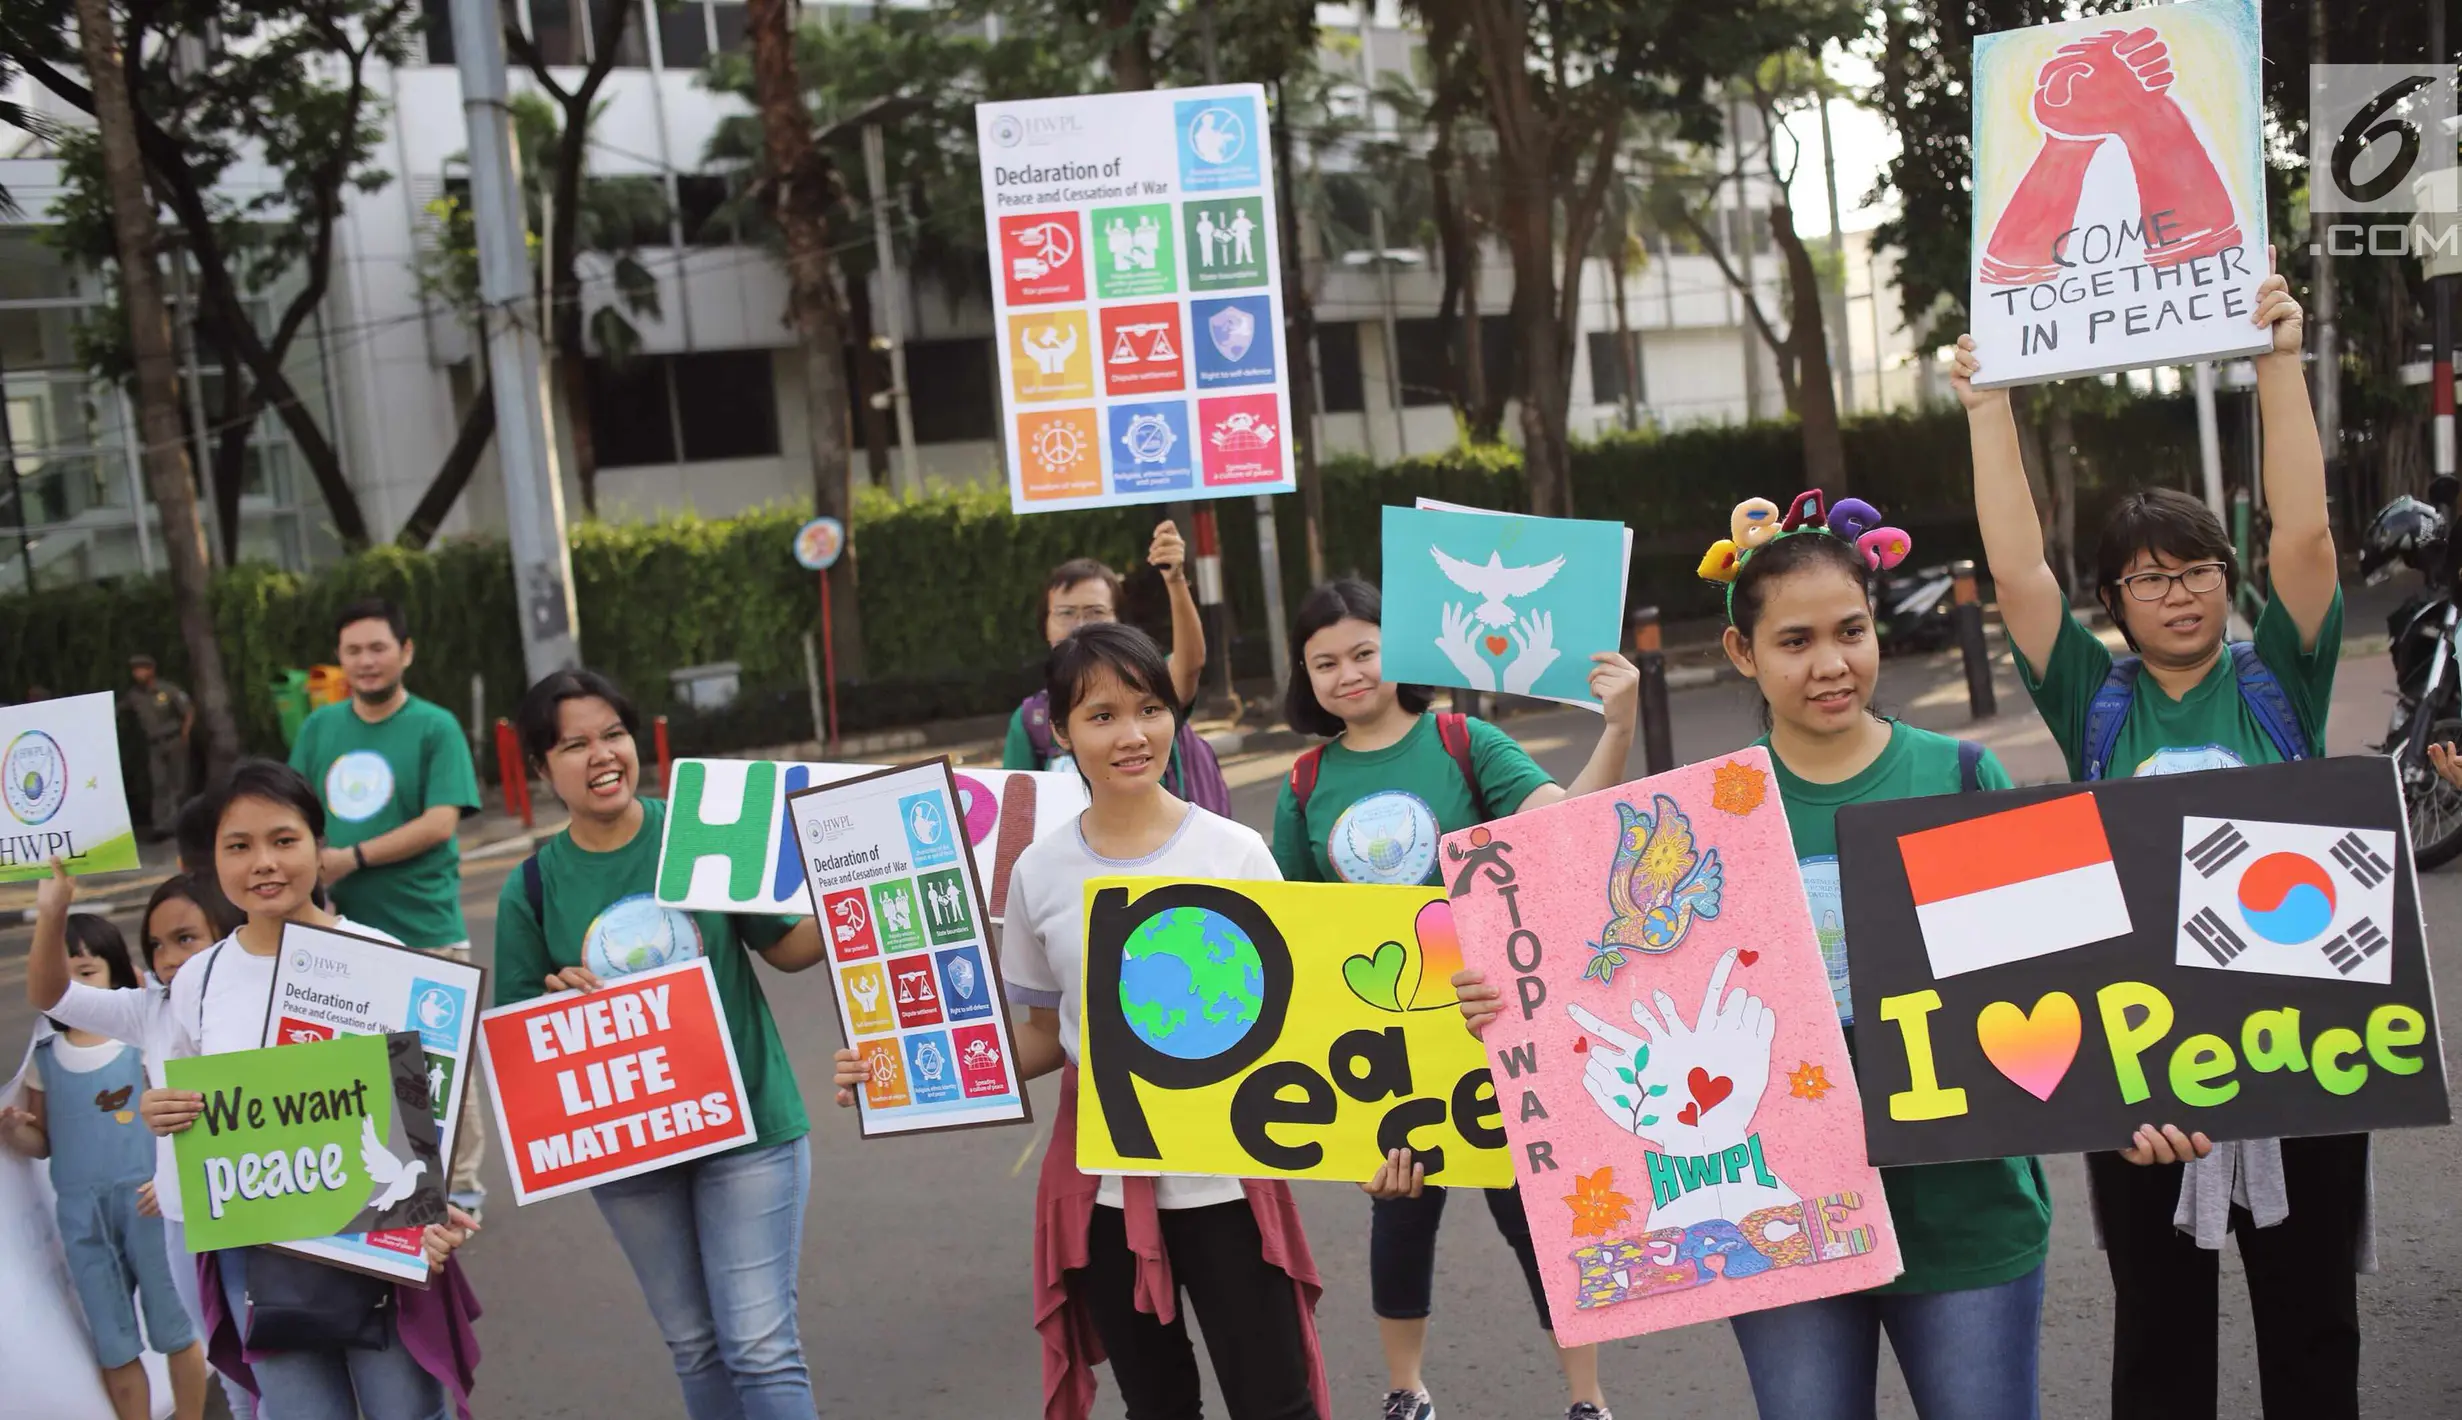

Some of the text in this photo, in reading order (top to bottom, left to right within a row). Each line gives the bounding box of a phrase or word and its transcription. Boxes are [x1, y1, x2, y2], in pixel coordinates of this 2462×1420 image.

[995, 157, 1121, 186] Declaration of
[998, 180, 1169, 207] Peace and Cessation of War
[2052, 208, 2183, 268] COME
[1991, 246, 2252, 316] TOGETHER
[2020, 287, 2248, 356] IN PEACE
[0, 831, 87, 867] HWPL
[823, 815, 854, 832] HWPL
[814, 844, 880, 873] Declaration of
[818, 861, 908, 888] Peace and Cessation of War
[314, 956, 351, 976] HWPL
[283, 1000, 397, 1034] Peace and Cessation of War
[286, 982, 370, 1015] Declaration of
[525, 984, 671, 1063] EVERY
[1086, 883, 1508, 1175] Peace
[1484, 841, 1559, 1175] STOP WAR
[556, 1046, 676, 1116] LIFE
[1880, 980, 2427, 1121] I Peace
[201, 1079, 367, 1136] We want
[527, 1092, 732, 1174] MATTERS
[204, 1143, 348, 1220] peace
[1644, 1132, 1778, 1211] HWPL
[1568, 1191, 1878, 1310] PEACE
